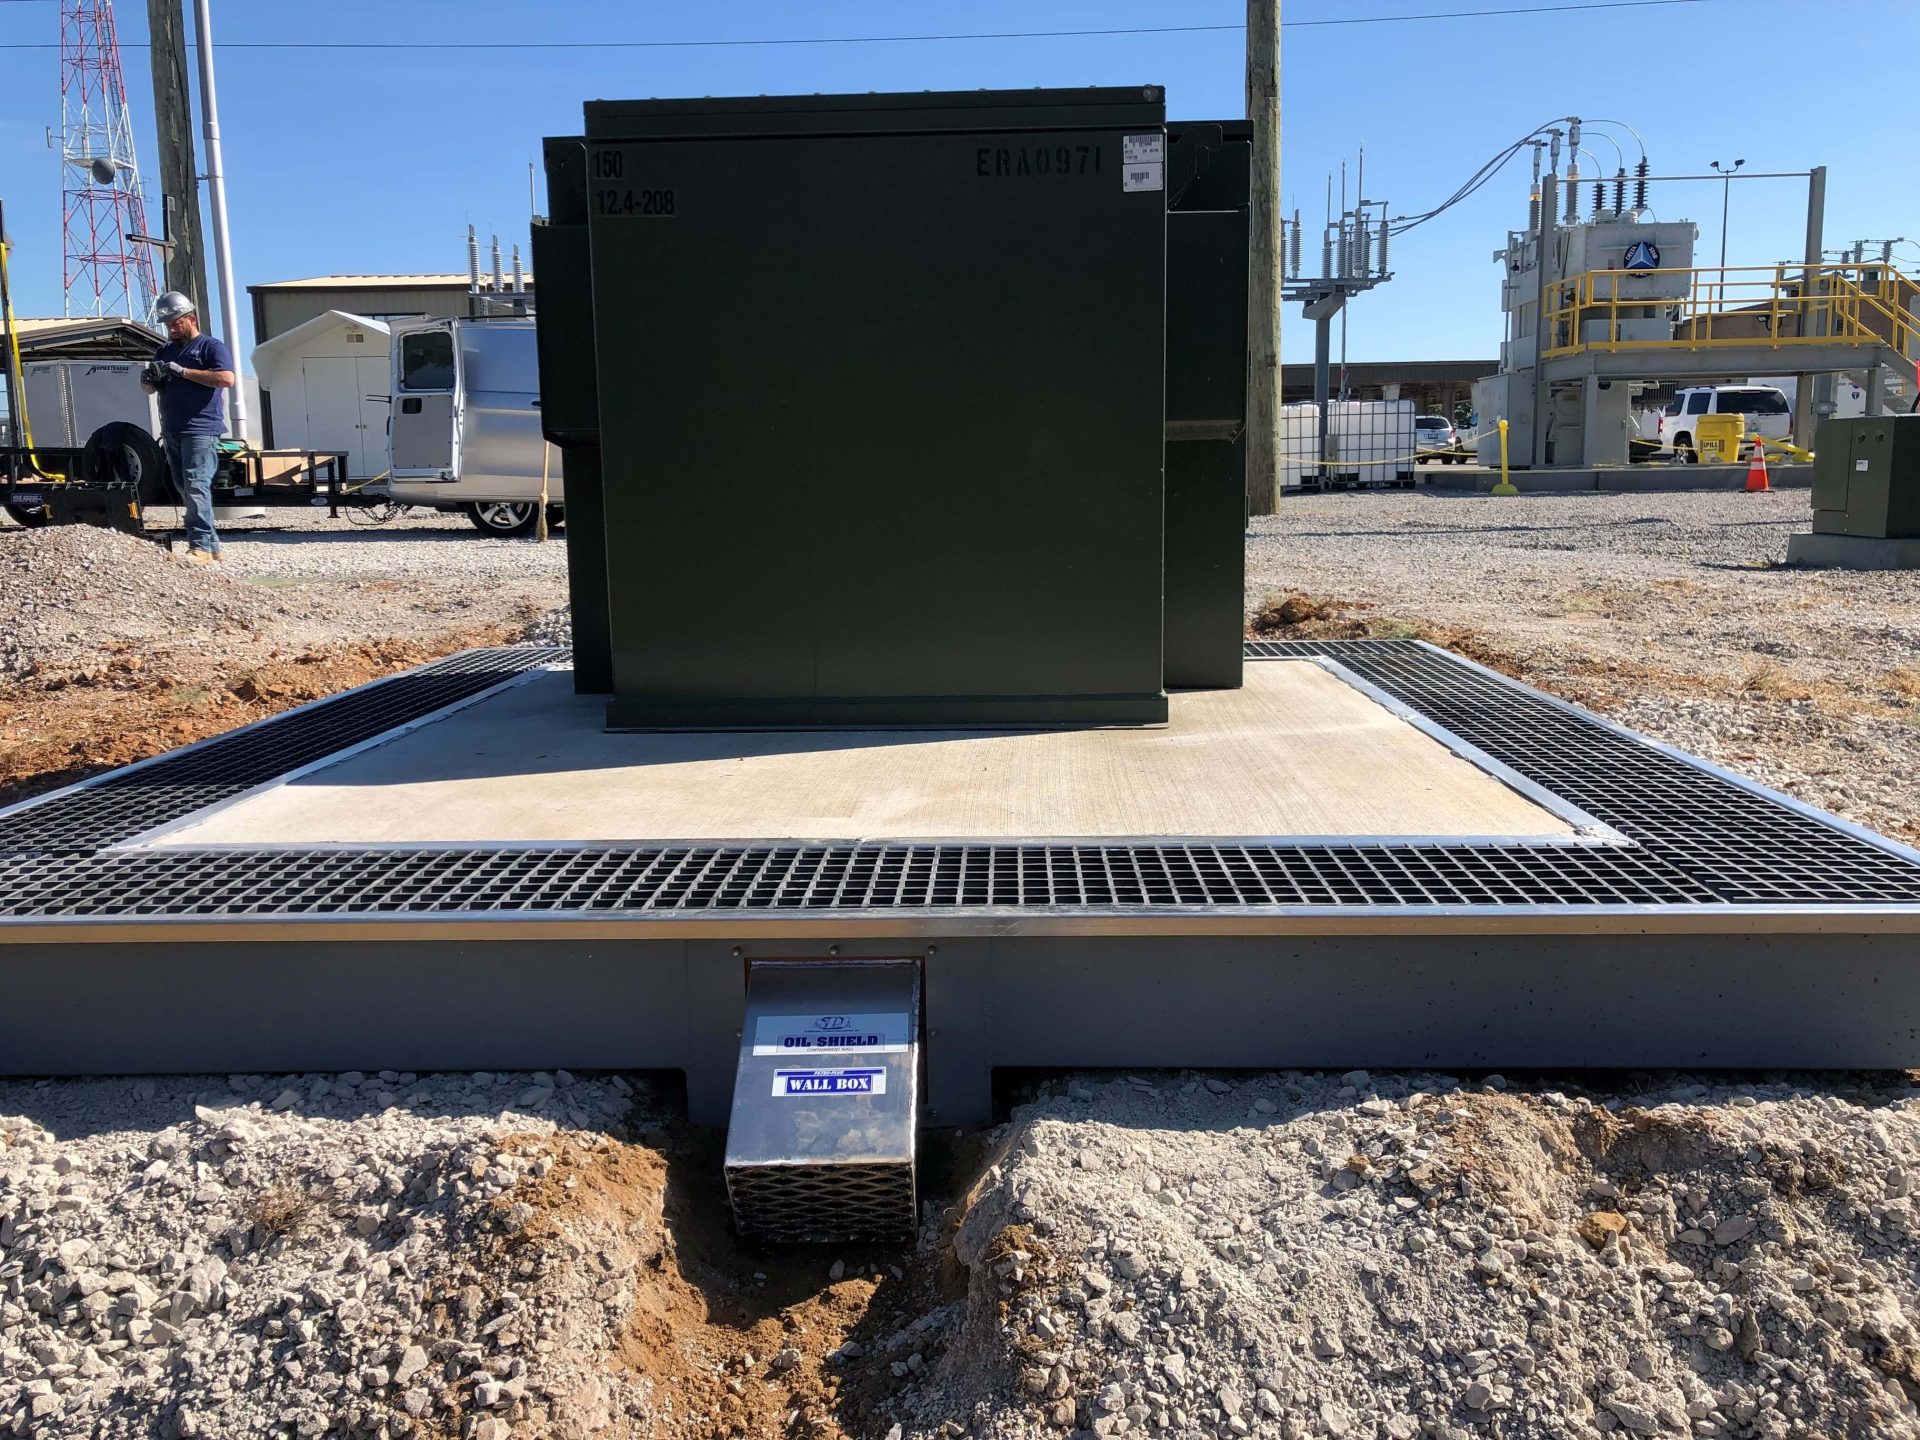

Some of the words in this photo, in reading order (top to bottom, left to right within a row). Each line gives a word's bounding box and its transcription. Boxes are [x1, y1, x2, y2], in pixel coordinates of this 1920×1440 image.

[592, 150, 623, 178] 150
[596, 189, 675, 215] 12.4-208
[1648, 246, 1659, 260] STAR
[783, 1036, 812, 1048] OIL
[816, 1035, 879, 1047] SHIELD
[789, 1078, 832, 1091] WALL
[836, 1077, 870, 1090] BOX
